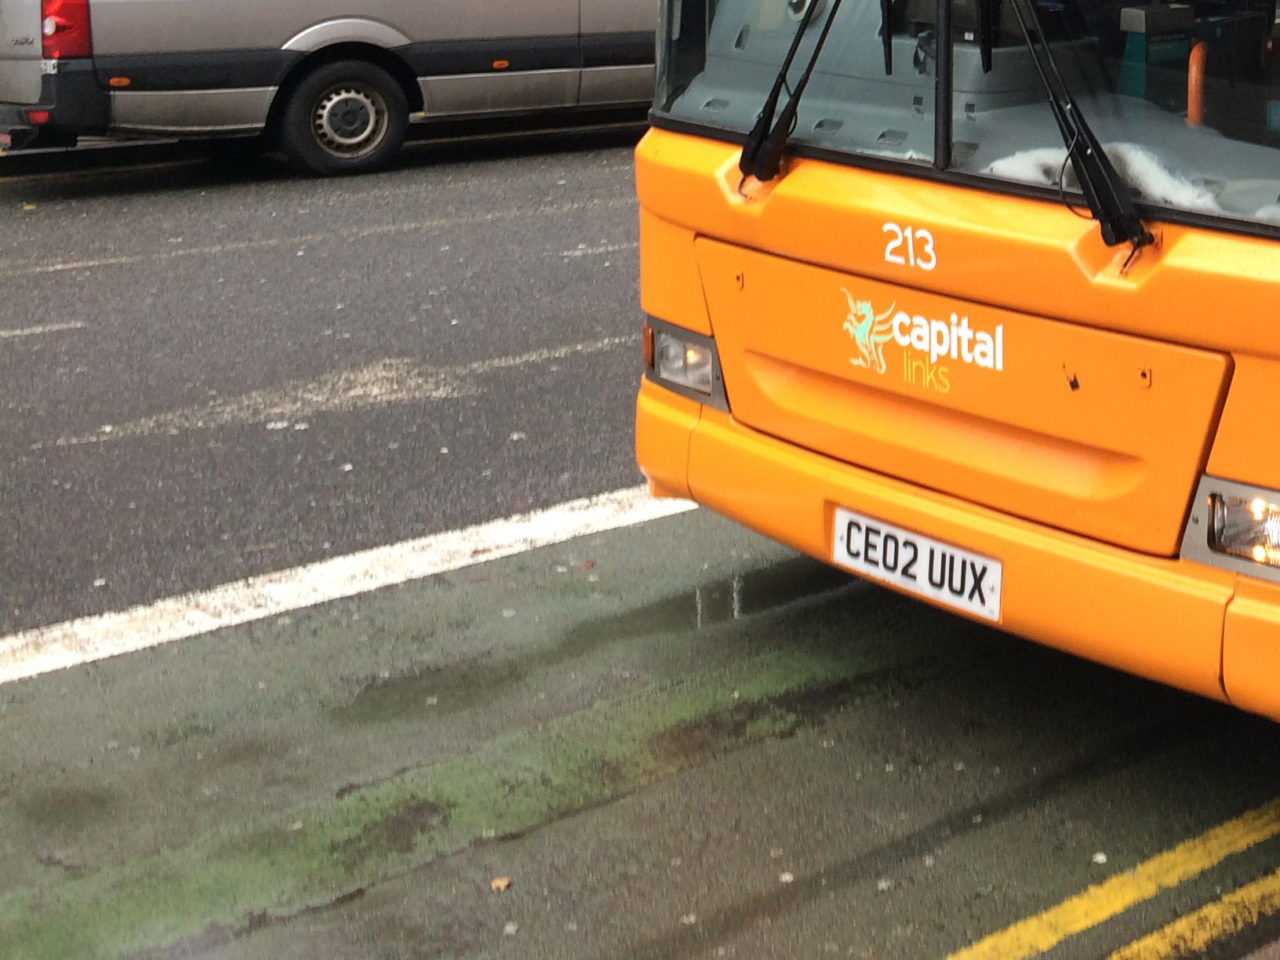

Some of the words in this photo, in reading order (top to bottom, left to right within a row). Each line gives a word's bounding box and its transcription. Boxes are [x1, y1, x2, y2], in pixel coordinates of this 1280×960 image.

[882, 222, 937, 271] 213
[892, 311, 1004, 371] capital
[902, 349, 951, 394] links
[845, 520, 918, 582] CE02
[928, 548, 988, 607] UUX
